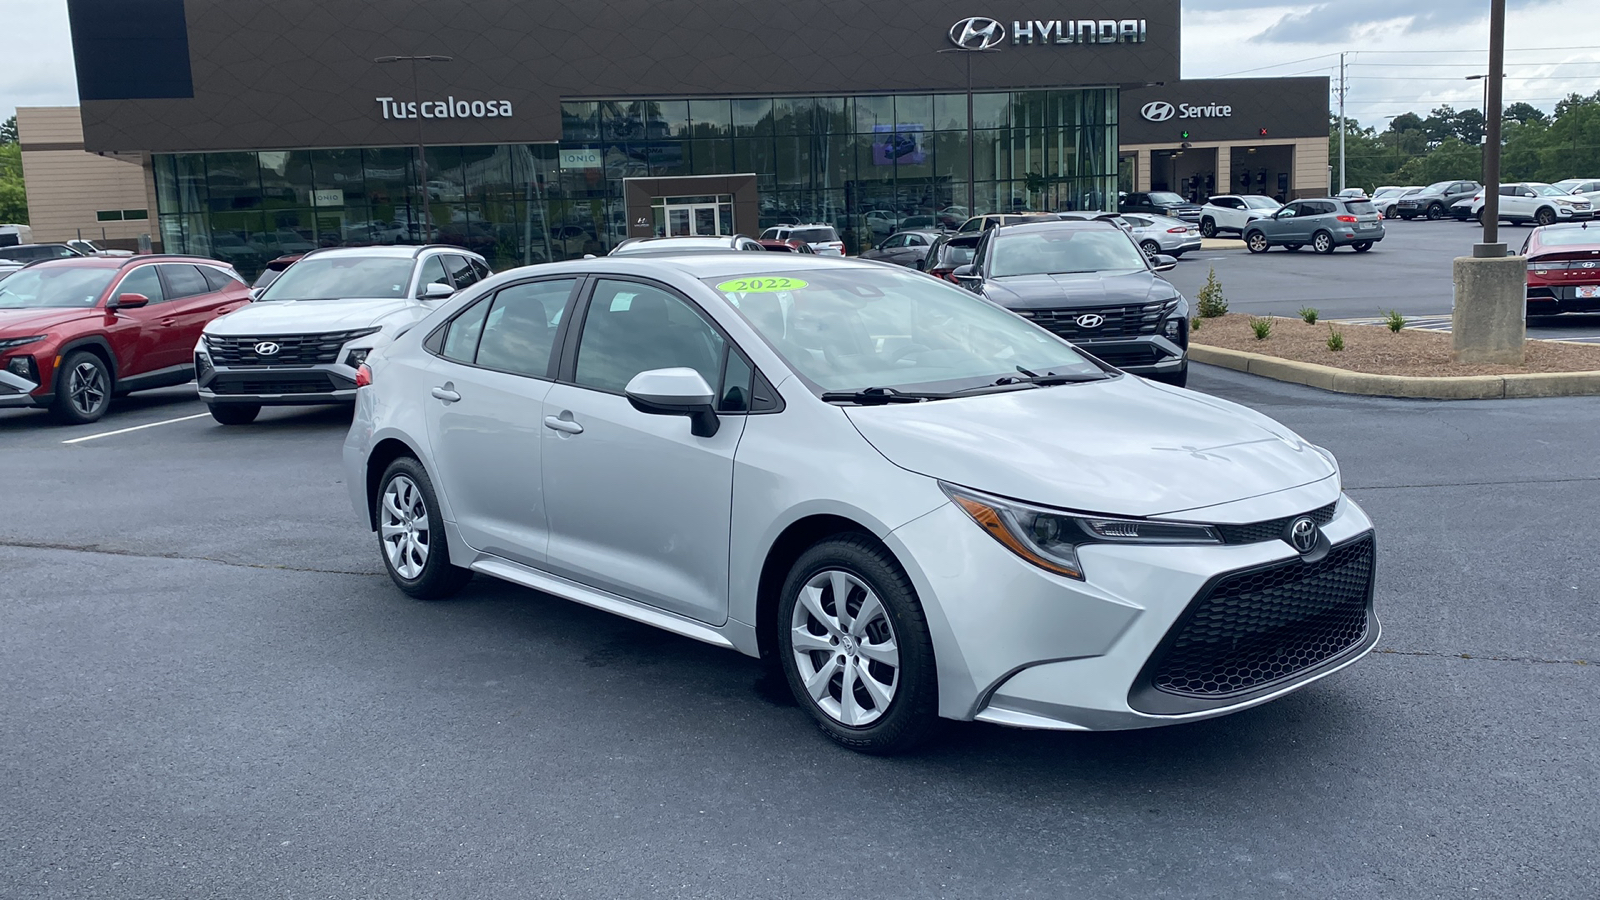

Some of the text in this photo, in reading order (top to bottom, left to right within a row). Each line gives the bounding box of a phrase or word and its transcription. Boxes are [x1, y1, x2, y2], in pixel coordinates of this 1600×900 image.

[1012, 19, 1147, 45] HYUNDAI
[375, 95, 513, 119] Tuscaloosa
[1178, 102, 1232, 119] Service
[735, 278, 792, 291] 2022
